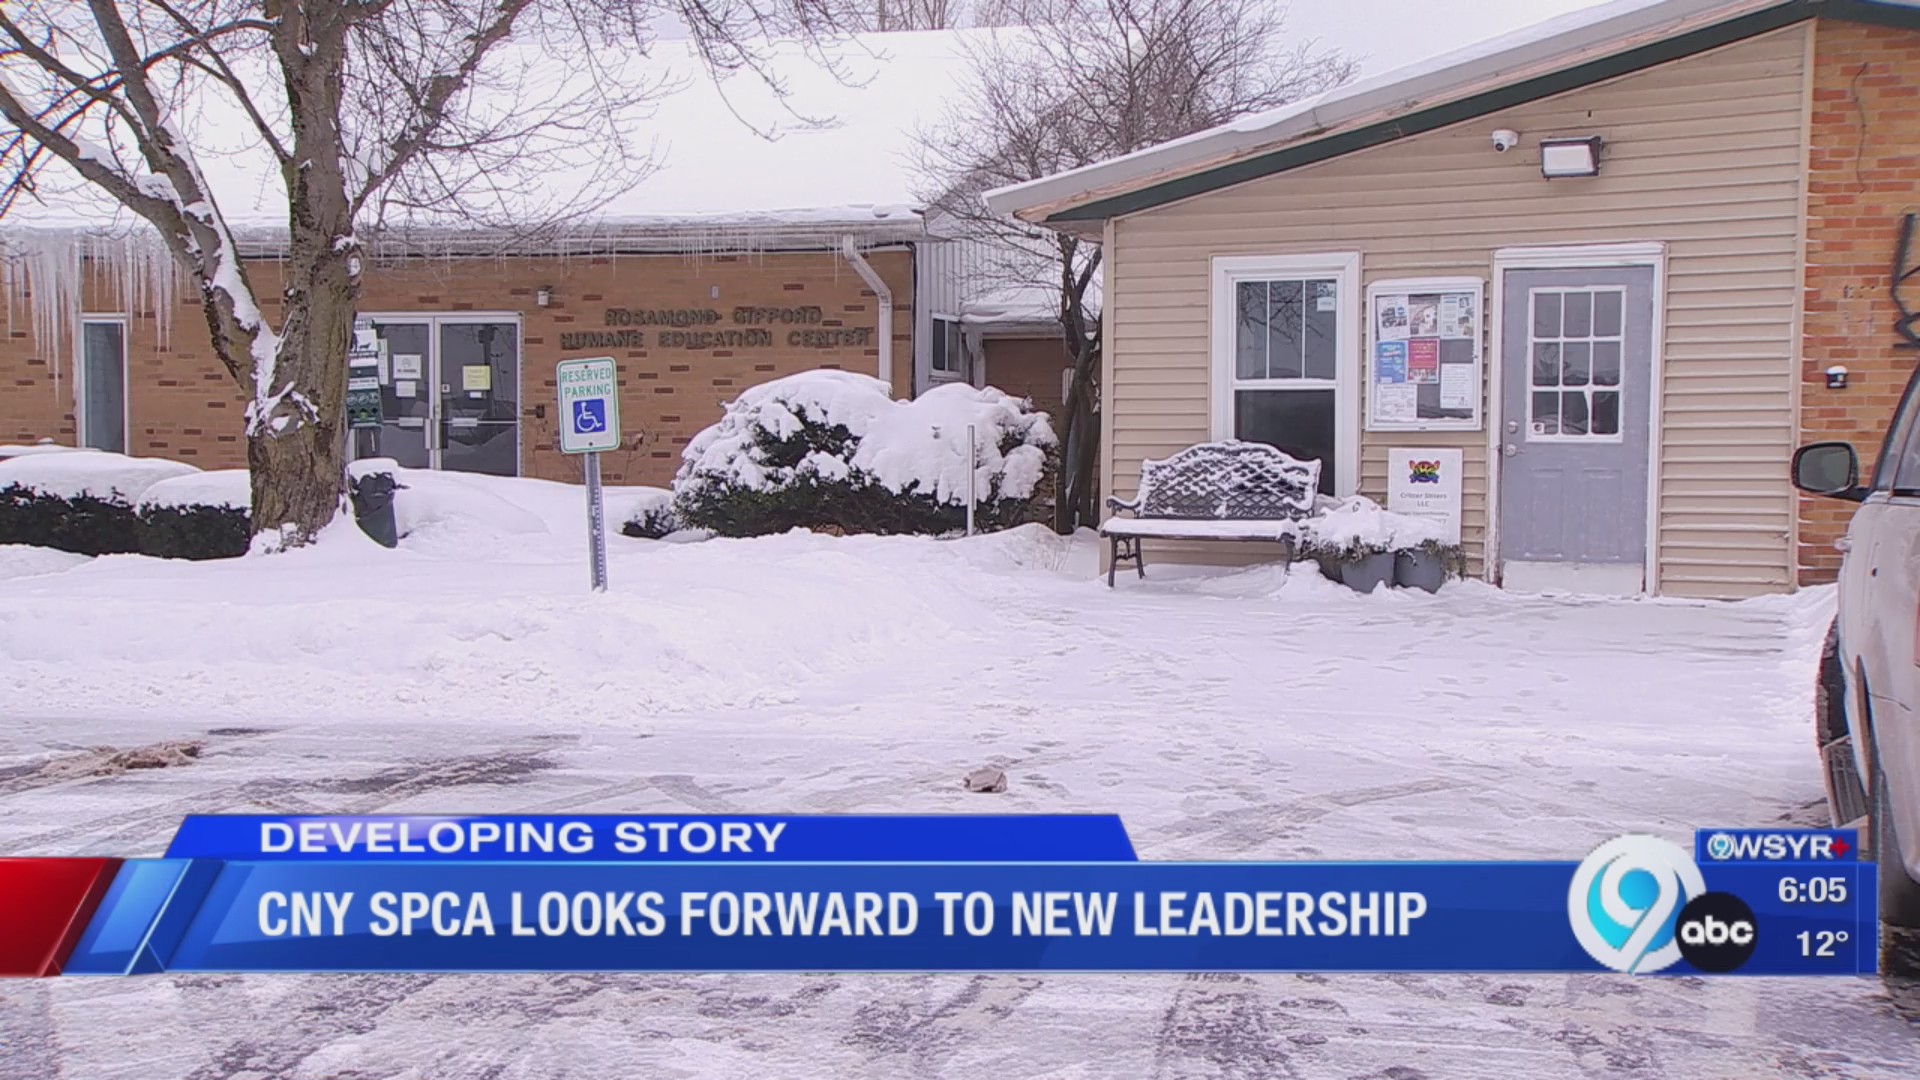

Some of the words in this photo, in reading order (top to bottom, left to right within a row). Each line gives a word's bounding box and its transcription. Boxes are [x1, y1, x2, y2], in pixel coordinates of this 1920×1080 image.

[604, 309, 718, 326] ROSAMOND
[733, 307, 822, 324] GIFFORD
[560, 332, 643, 348] HUMANE
[658, 330, 772, 347] EDUCATION
[787, 329, 871, 346] CENTER
[561, 367, 611, 382] RESERVED
[564, 383, 611, 398] PARKING
